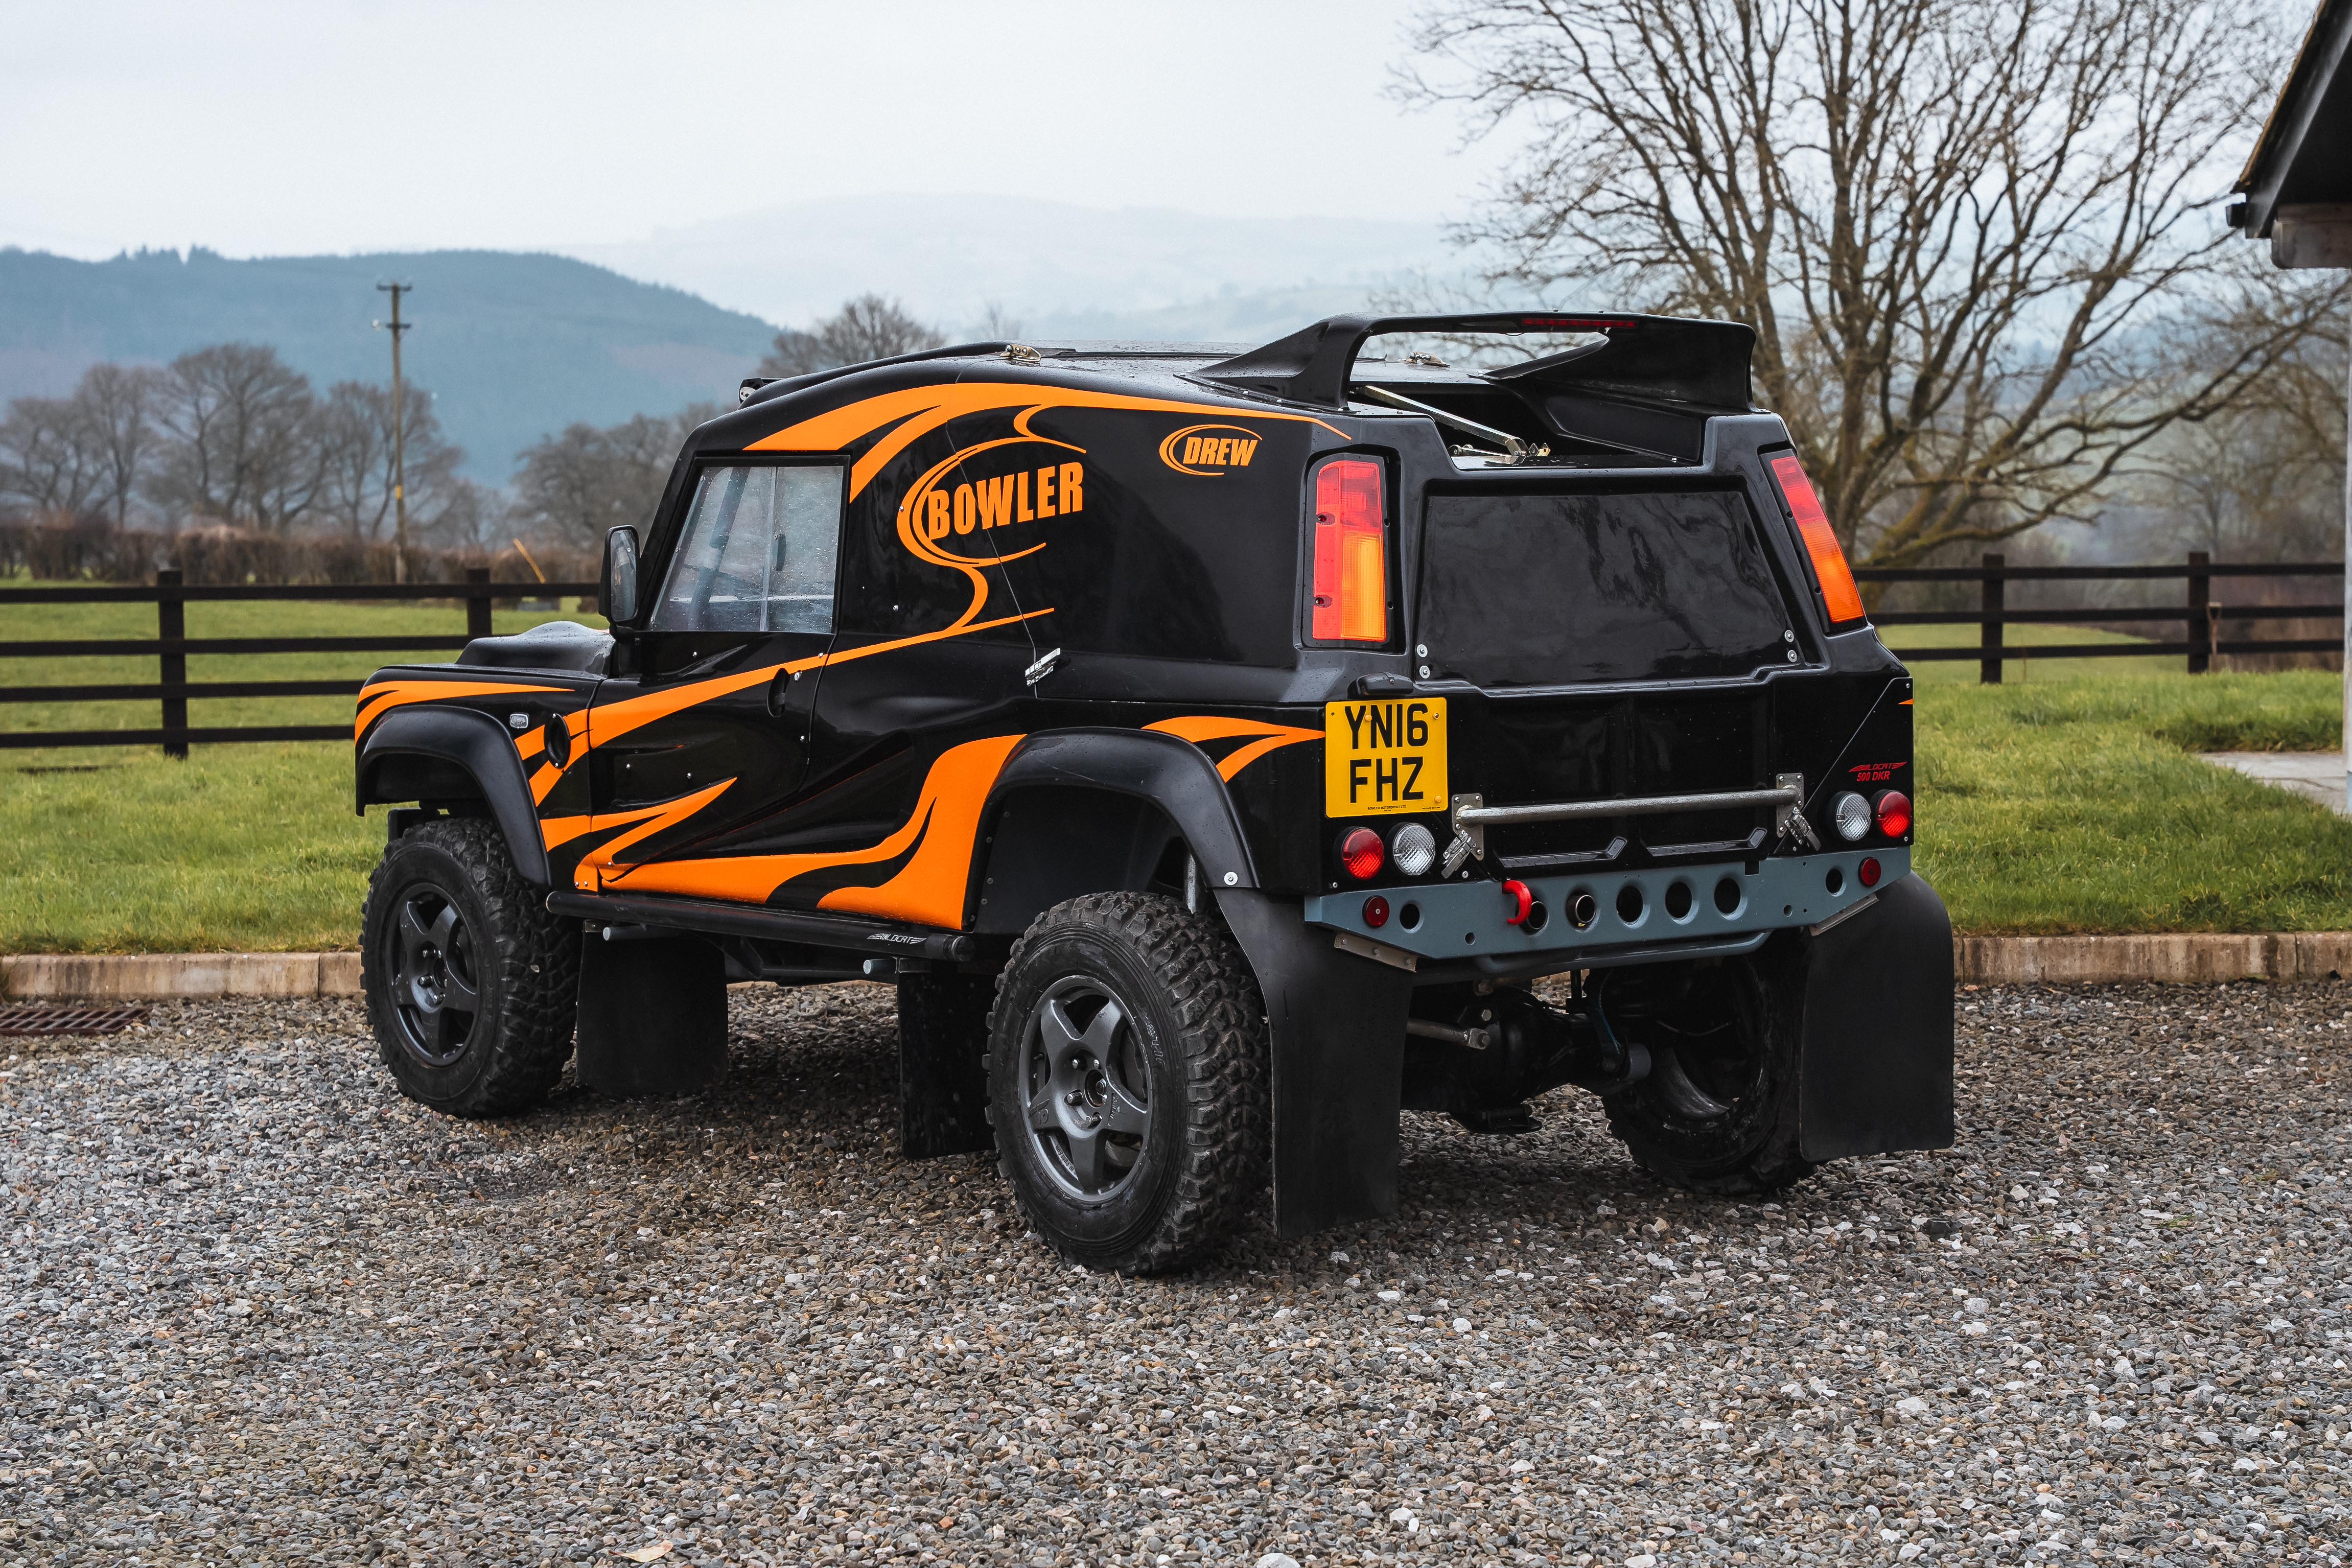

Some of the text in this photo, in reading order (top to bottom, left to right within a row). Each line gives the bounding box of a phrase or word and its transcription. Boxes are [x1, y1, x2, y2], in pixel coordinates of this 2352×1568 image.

[1183, 437, 1258, 466] DREW
[928, 462, 1083, 541] BOWLER
[1344, 703, 1429, 750] YN16
[1349, 756, 1424, 804] FHZ
[1857, 771, 1890, 781] 500 DKR
